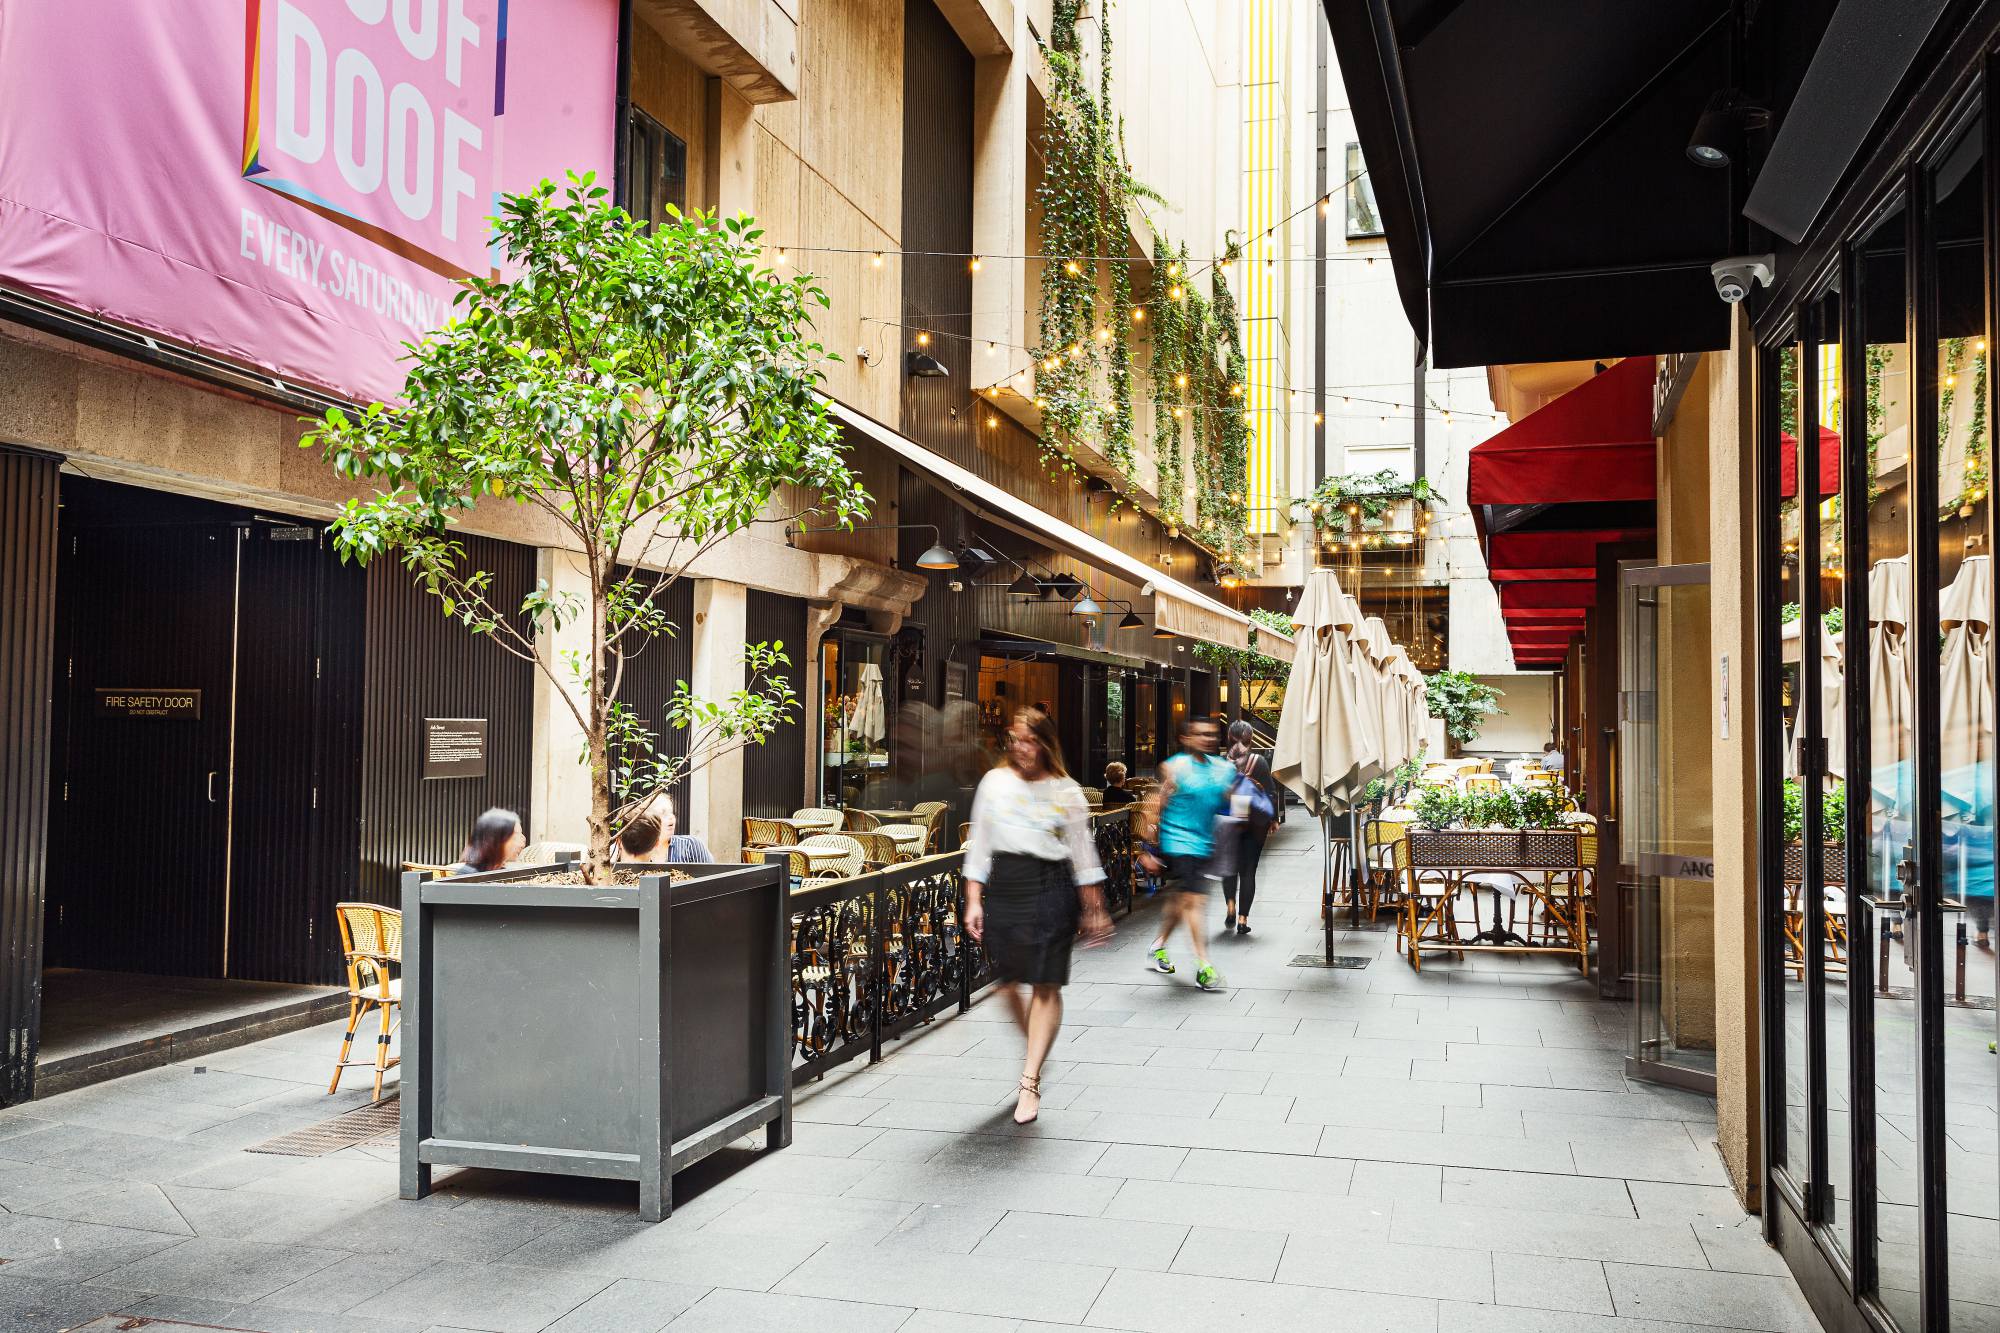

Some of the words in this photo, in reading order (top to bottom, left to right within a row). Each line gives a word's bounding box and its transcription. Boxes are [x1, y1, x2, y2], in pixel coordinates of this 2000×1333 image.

[275, 0, 482, 242] DOOF
[106, 696, 126, 707] FIRE
[127, 696, 163, 708] SAFETY
[164, 697, 193, 708] DOOR
